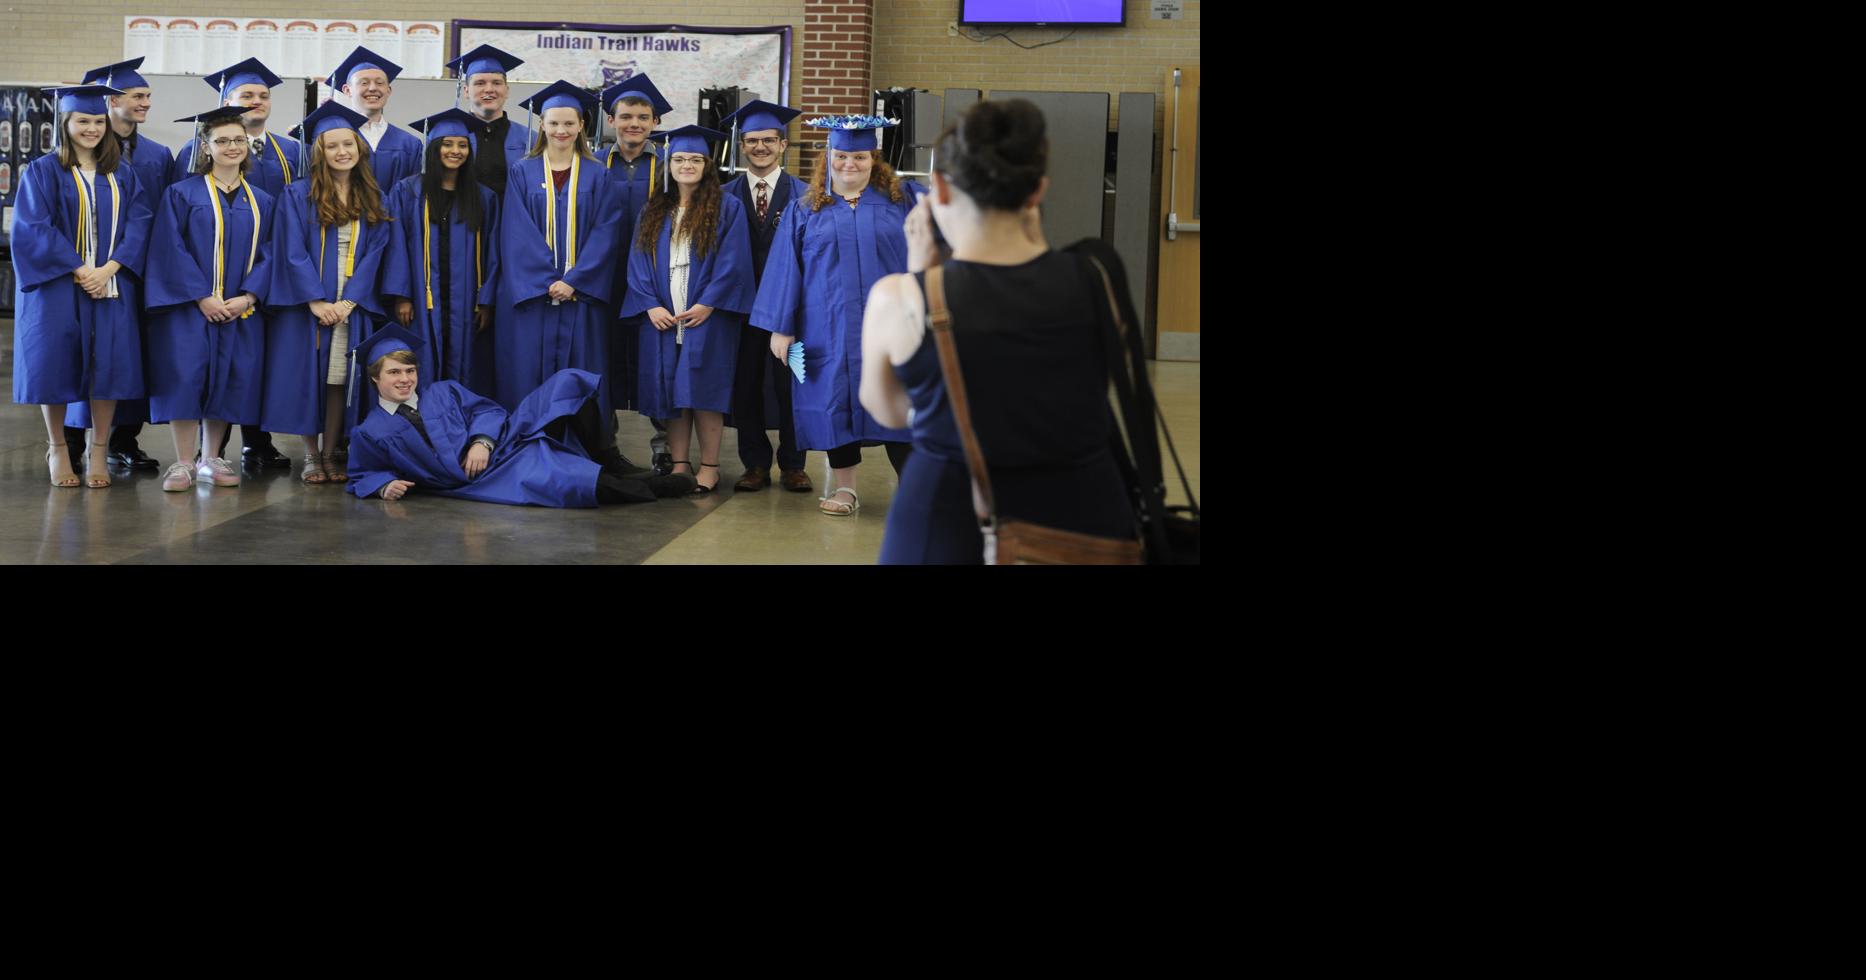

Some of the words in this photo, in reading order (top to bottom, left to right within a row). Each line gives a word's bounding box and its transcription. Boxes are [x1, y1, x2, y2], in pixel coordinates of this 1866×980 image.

[537, 34, 593, 49] Indian
[598, 36, 637, 51] Trail
[643, 36, 701, 52] Hawks
